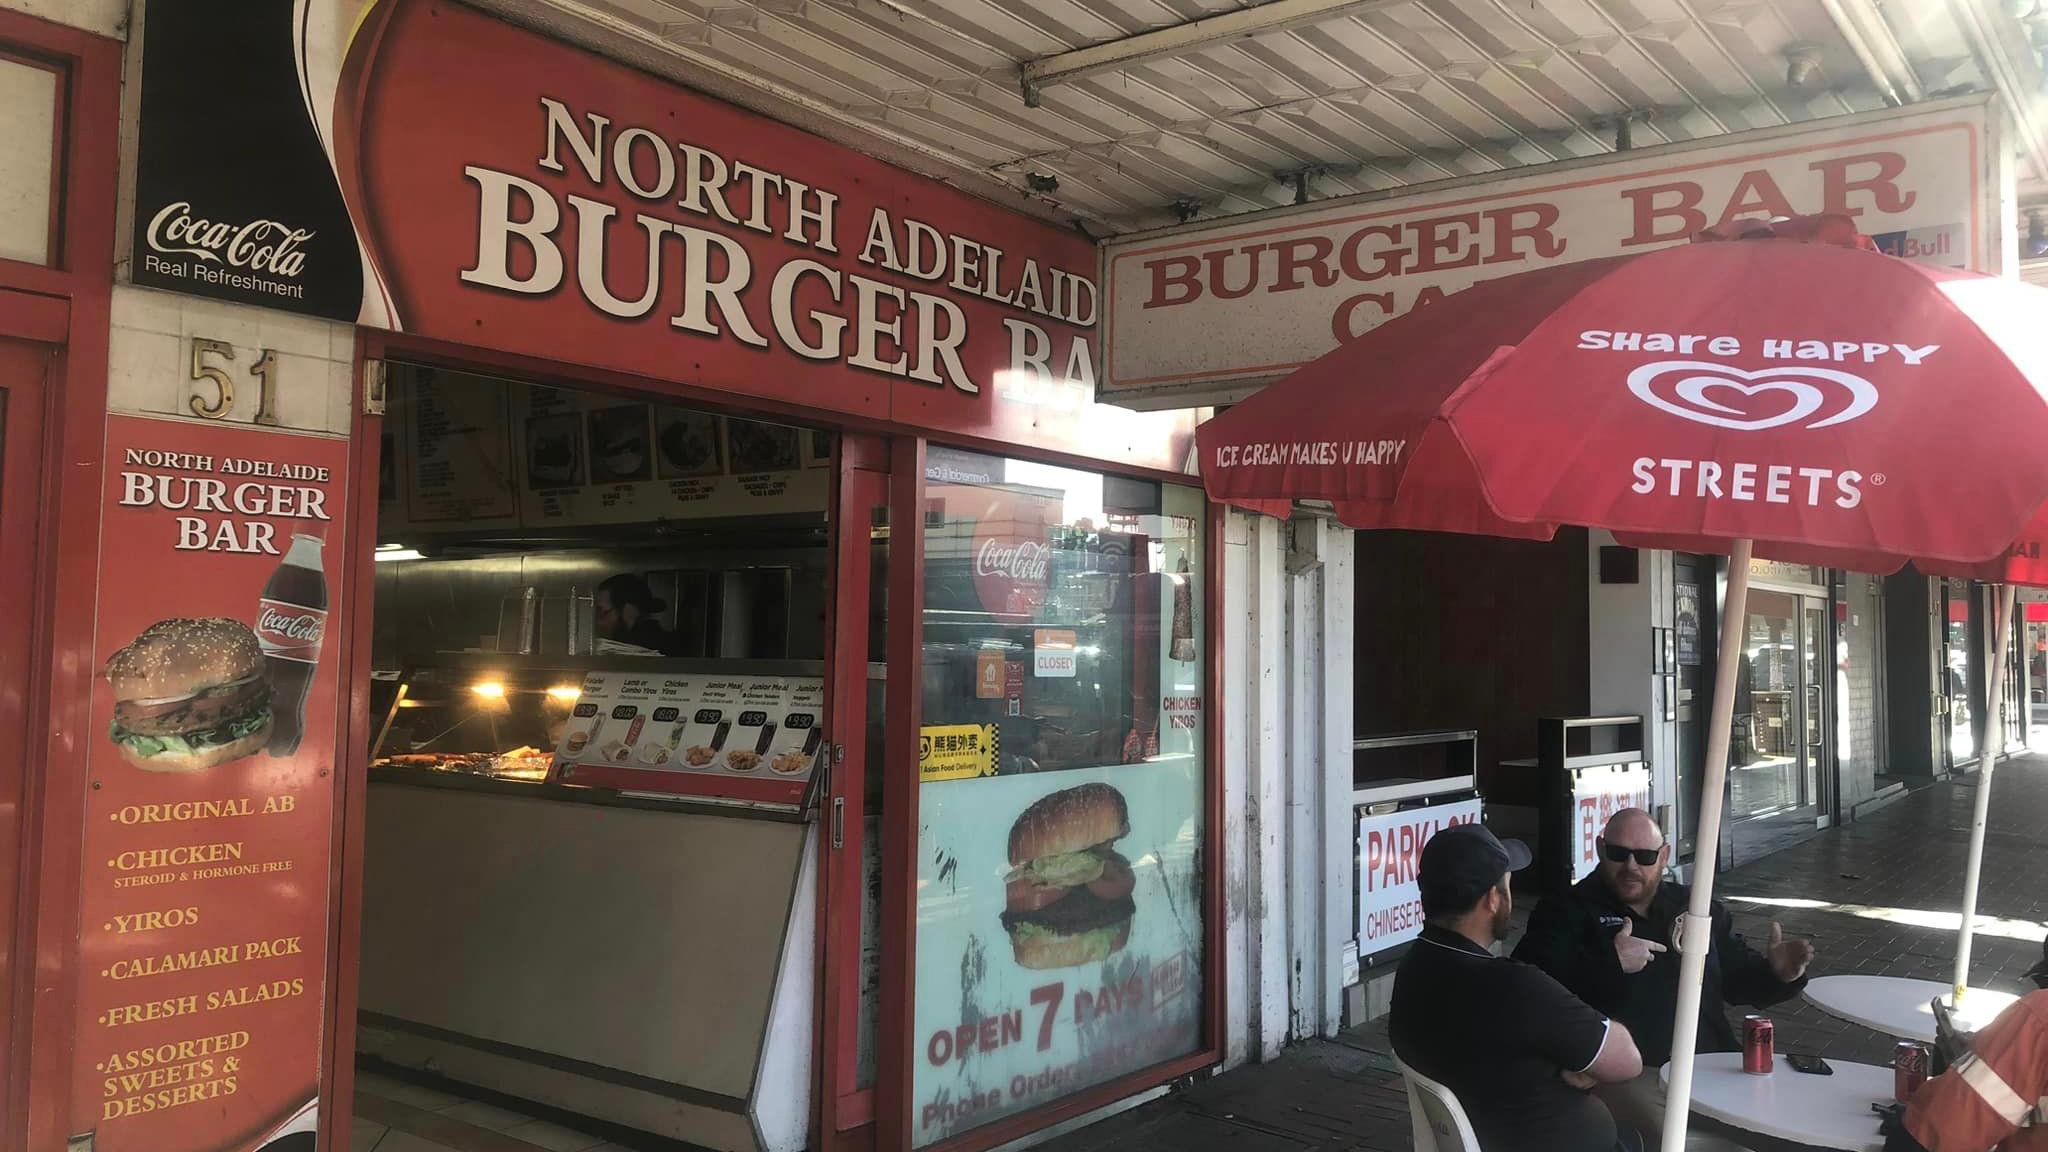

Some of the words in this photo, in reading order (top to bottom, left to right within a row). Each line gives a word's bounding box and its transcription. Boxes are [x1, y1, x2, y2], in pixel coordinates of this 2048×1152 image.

[539, 98, 839, 254] NORTH
[147, 201, 315, 278] Coca-Cola
[1143, 201, 1567, 310] BURGER
[1621, 151, 1917, 248] BAR
[1904, 232, 1951, 258] Bull
[145, 255, 188, 278] Real
[194, 263, 304, 299] Refreshment
[461, 165, 978, 394] BURGER
[189, 337, 281, 426] 51
[125, 448, 213, 471] NORTH
[220, 458, 329, 482] ADELAIDE
[1216, 446, 1239, 467] ICE
[1242, 443, 1290, 466] CREAM
[1291, 442, 1338, 465] MAKES
[1342, 442, 1353, 465] U
[1355, 440, 1406, 465] HAPPY
[119, 471, 331, 520] BURGER
[174, 516, 281, 555] BAR
[976, 538, 1050, 580] Coca-Cola
[259, 607, 324, 642] Coca-Cola
[1038, 656, 1074, 670] CLOSED
[1163, 696, 1201, 711] CHICKEN
[1169, 715, 1196, 729] YIROS
[923, 765, 940, 773] Asian
[955, 762, 977, 770] Delivery
[118, 798, 255, 825] ORIGINAL
[262, 795, 295, 815] AB
[114, 871, 175, 889] STEROID
[179, 869, 189, 882] &
[192, 862, 260, 880] HORMONE
[262, 860, 293, 874] FREE
[115, 842, 243, 871] CHICKEN
[1367, 821, 1430, 892] PARK
[112, 906, 199, 935] YIROS
[1366, 901, 1413, 941] CHINESE
[110, 944, 238, 981] CALAMARI
[244, 936, 302, 962] PACK
[106, 994, 198, 1027] FRESH
[206, 977, 304, 1011] SALADS
[926, 1009, 1023, 1068] OPEN
[1030, 981, 1065, 1053] 7
[103, 1030, 249, 1075] ASSORTED
[103, 1058, 214, 1097] SWEETS
[221, 1055, 241, 1074] &
[102, 1076, 239, 1121] DESSERTS
[922, 1087, 1001, 1131] Phone
